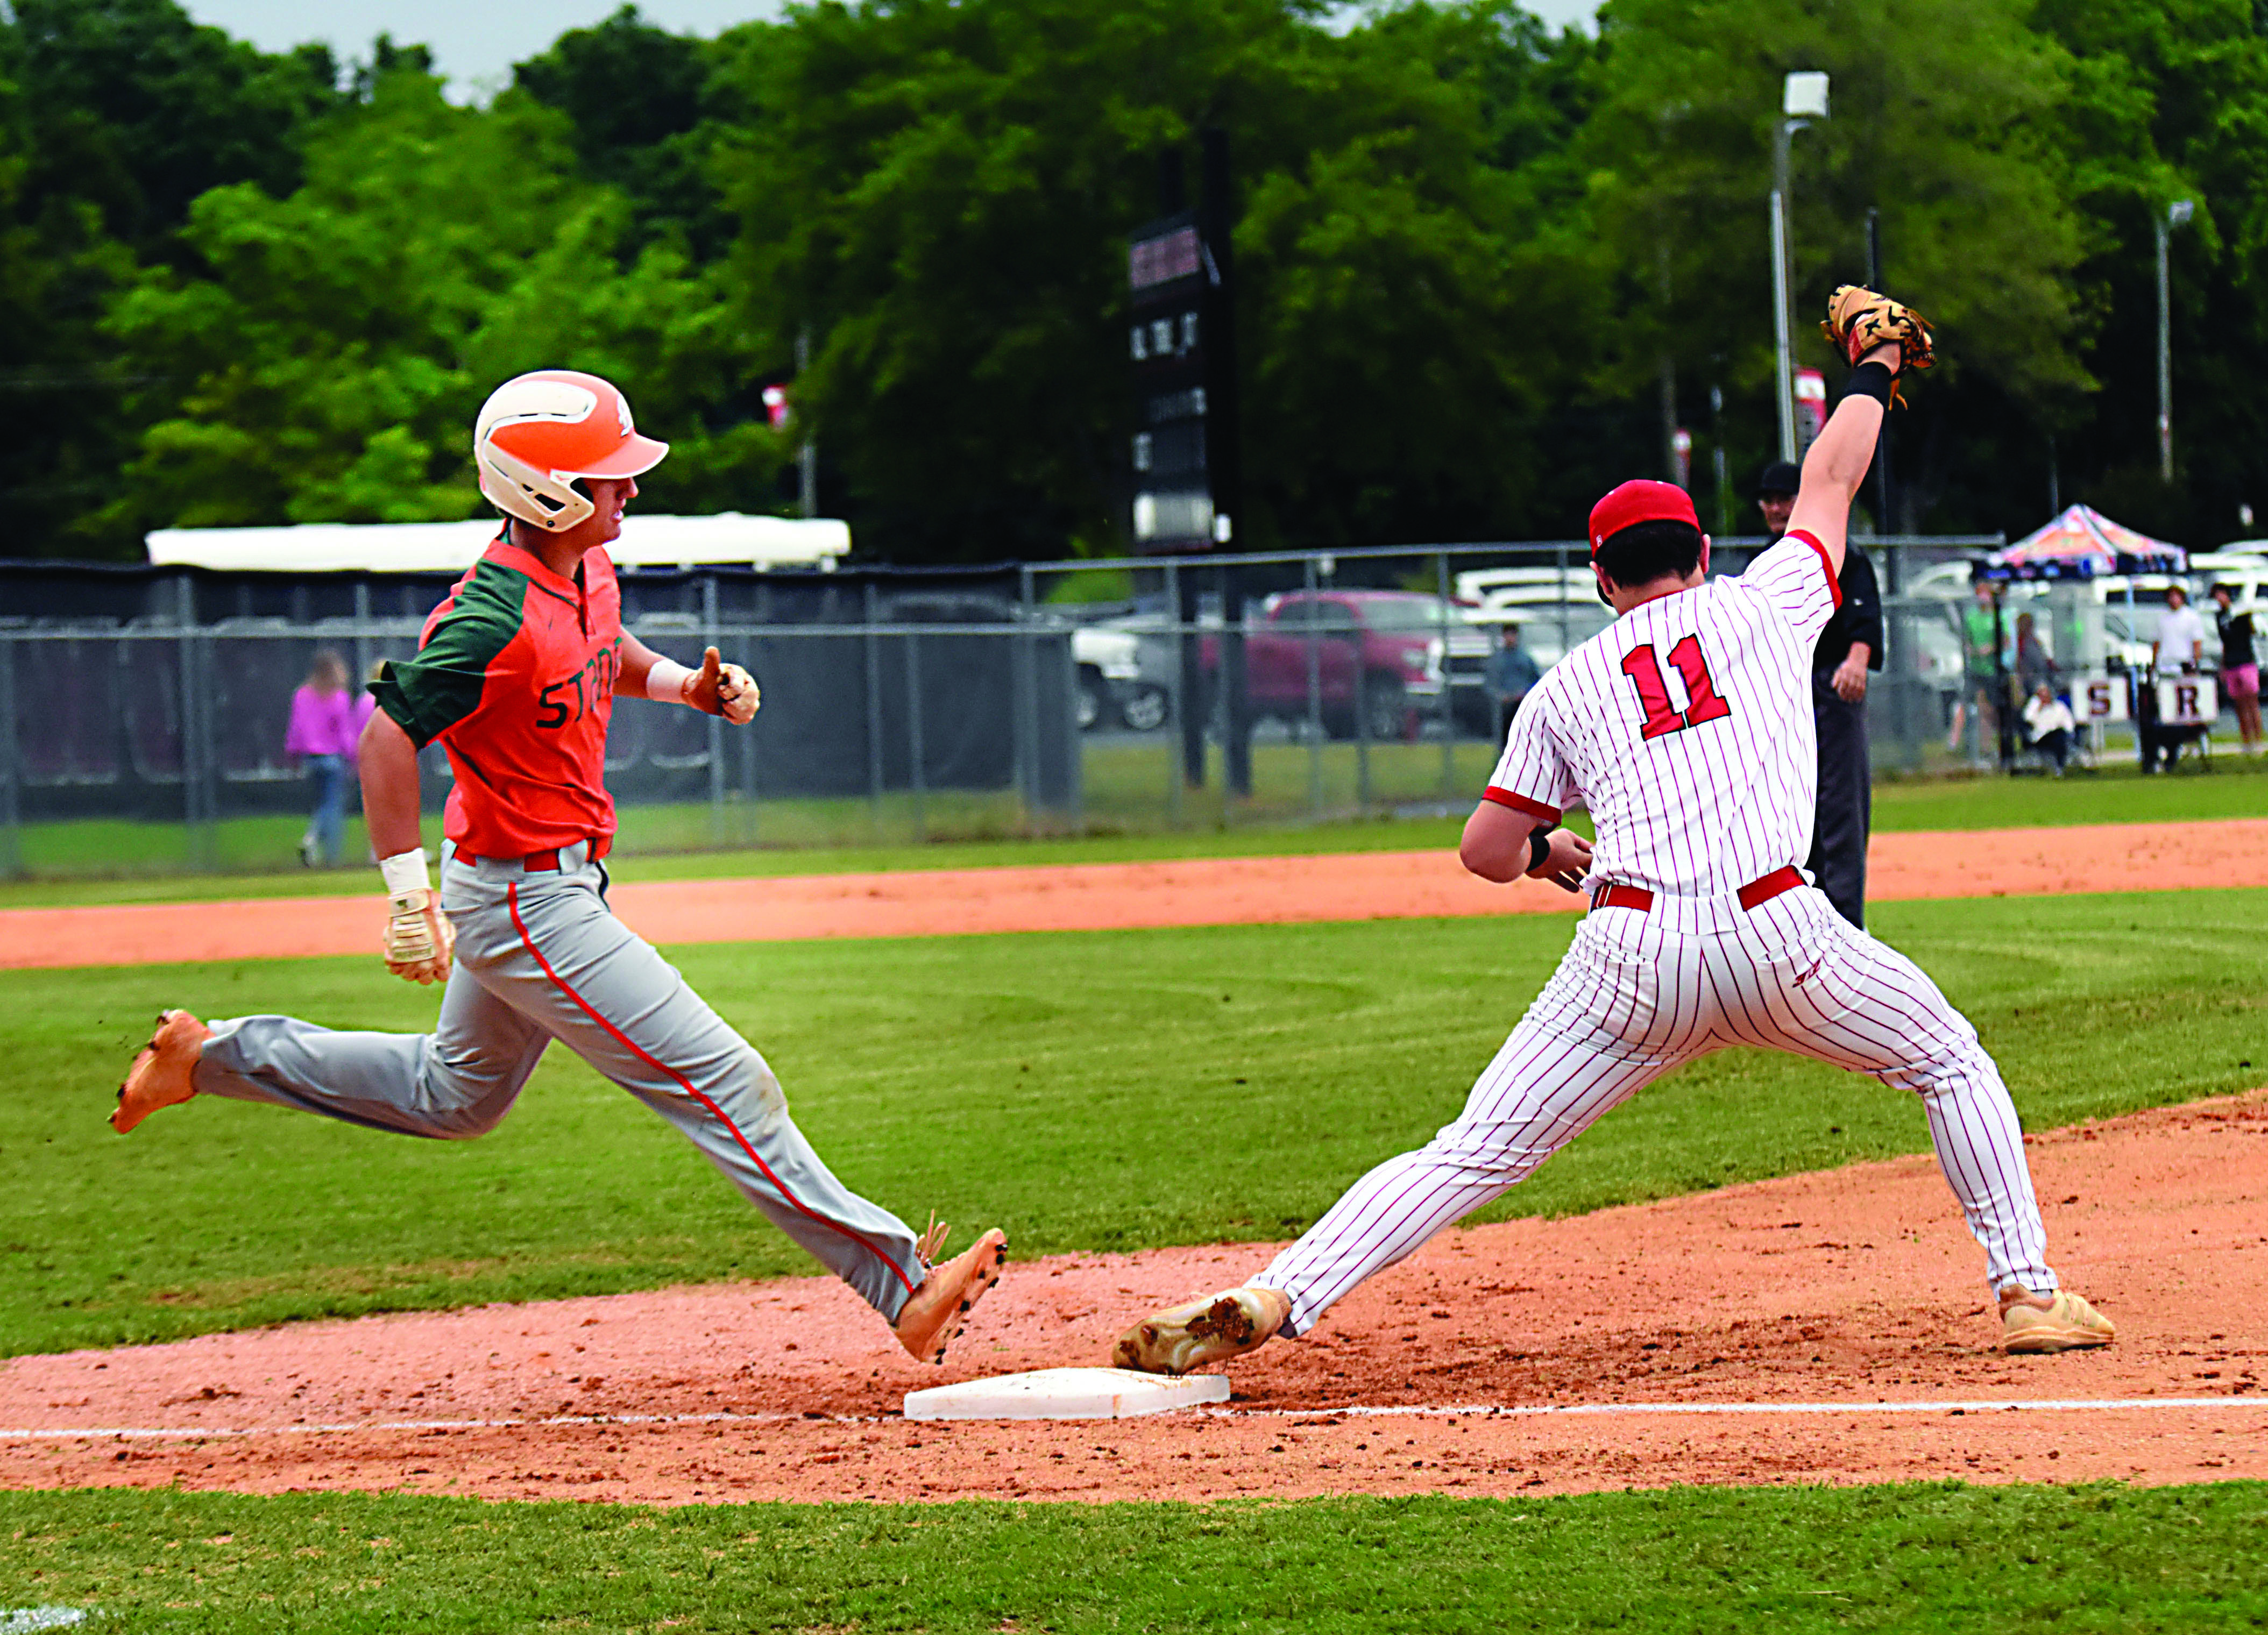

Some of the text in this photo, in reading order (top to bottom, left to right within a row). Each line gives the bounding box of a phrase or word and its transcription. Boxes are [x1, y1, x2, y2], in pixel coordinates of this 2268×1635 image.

[1620, 632, 1732, 742] 11
[2087, 683, 2110, 715] S
[2177, 685, 2199, 715] R
